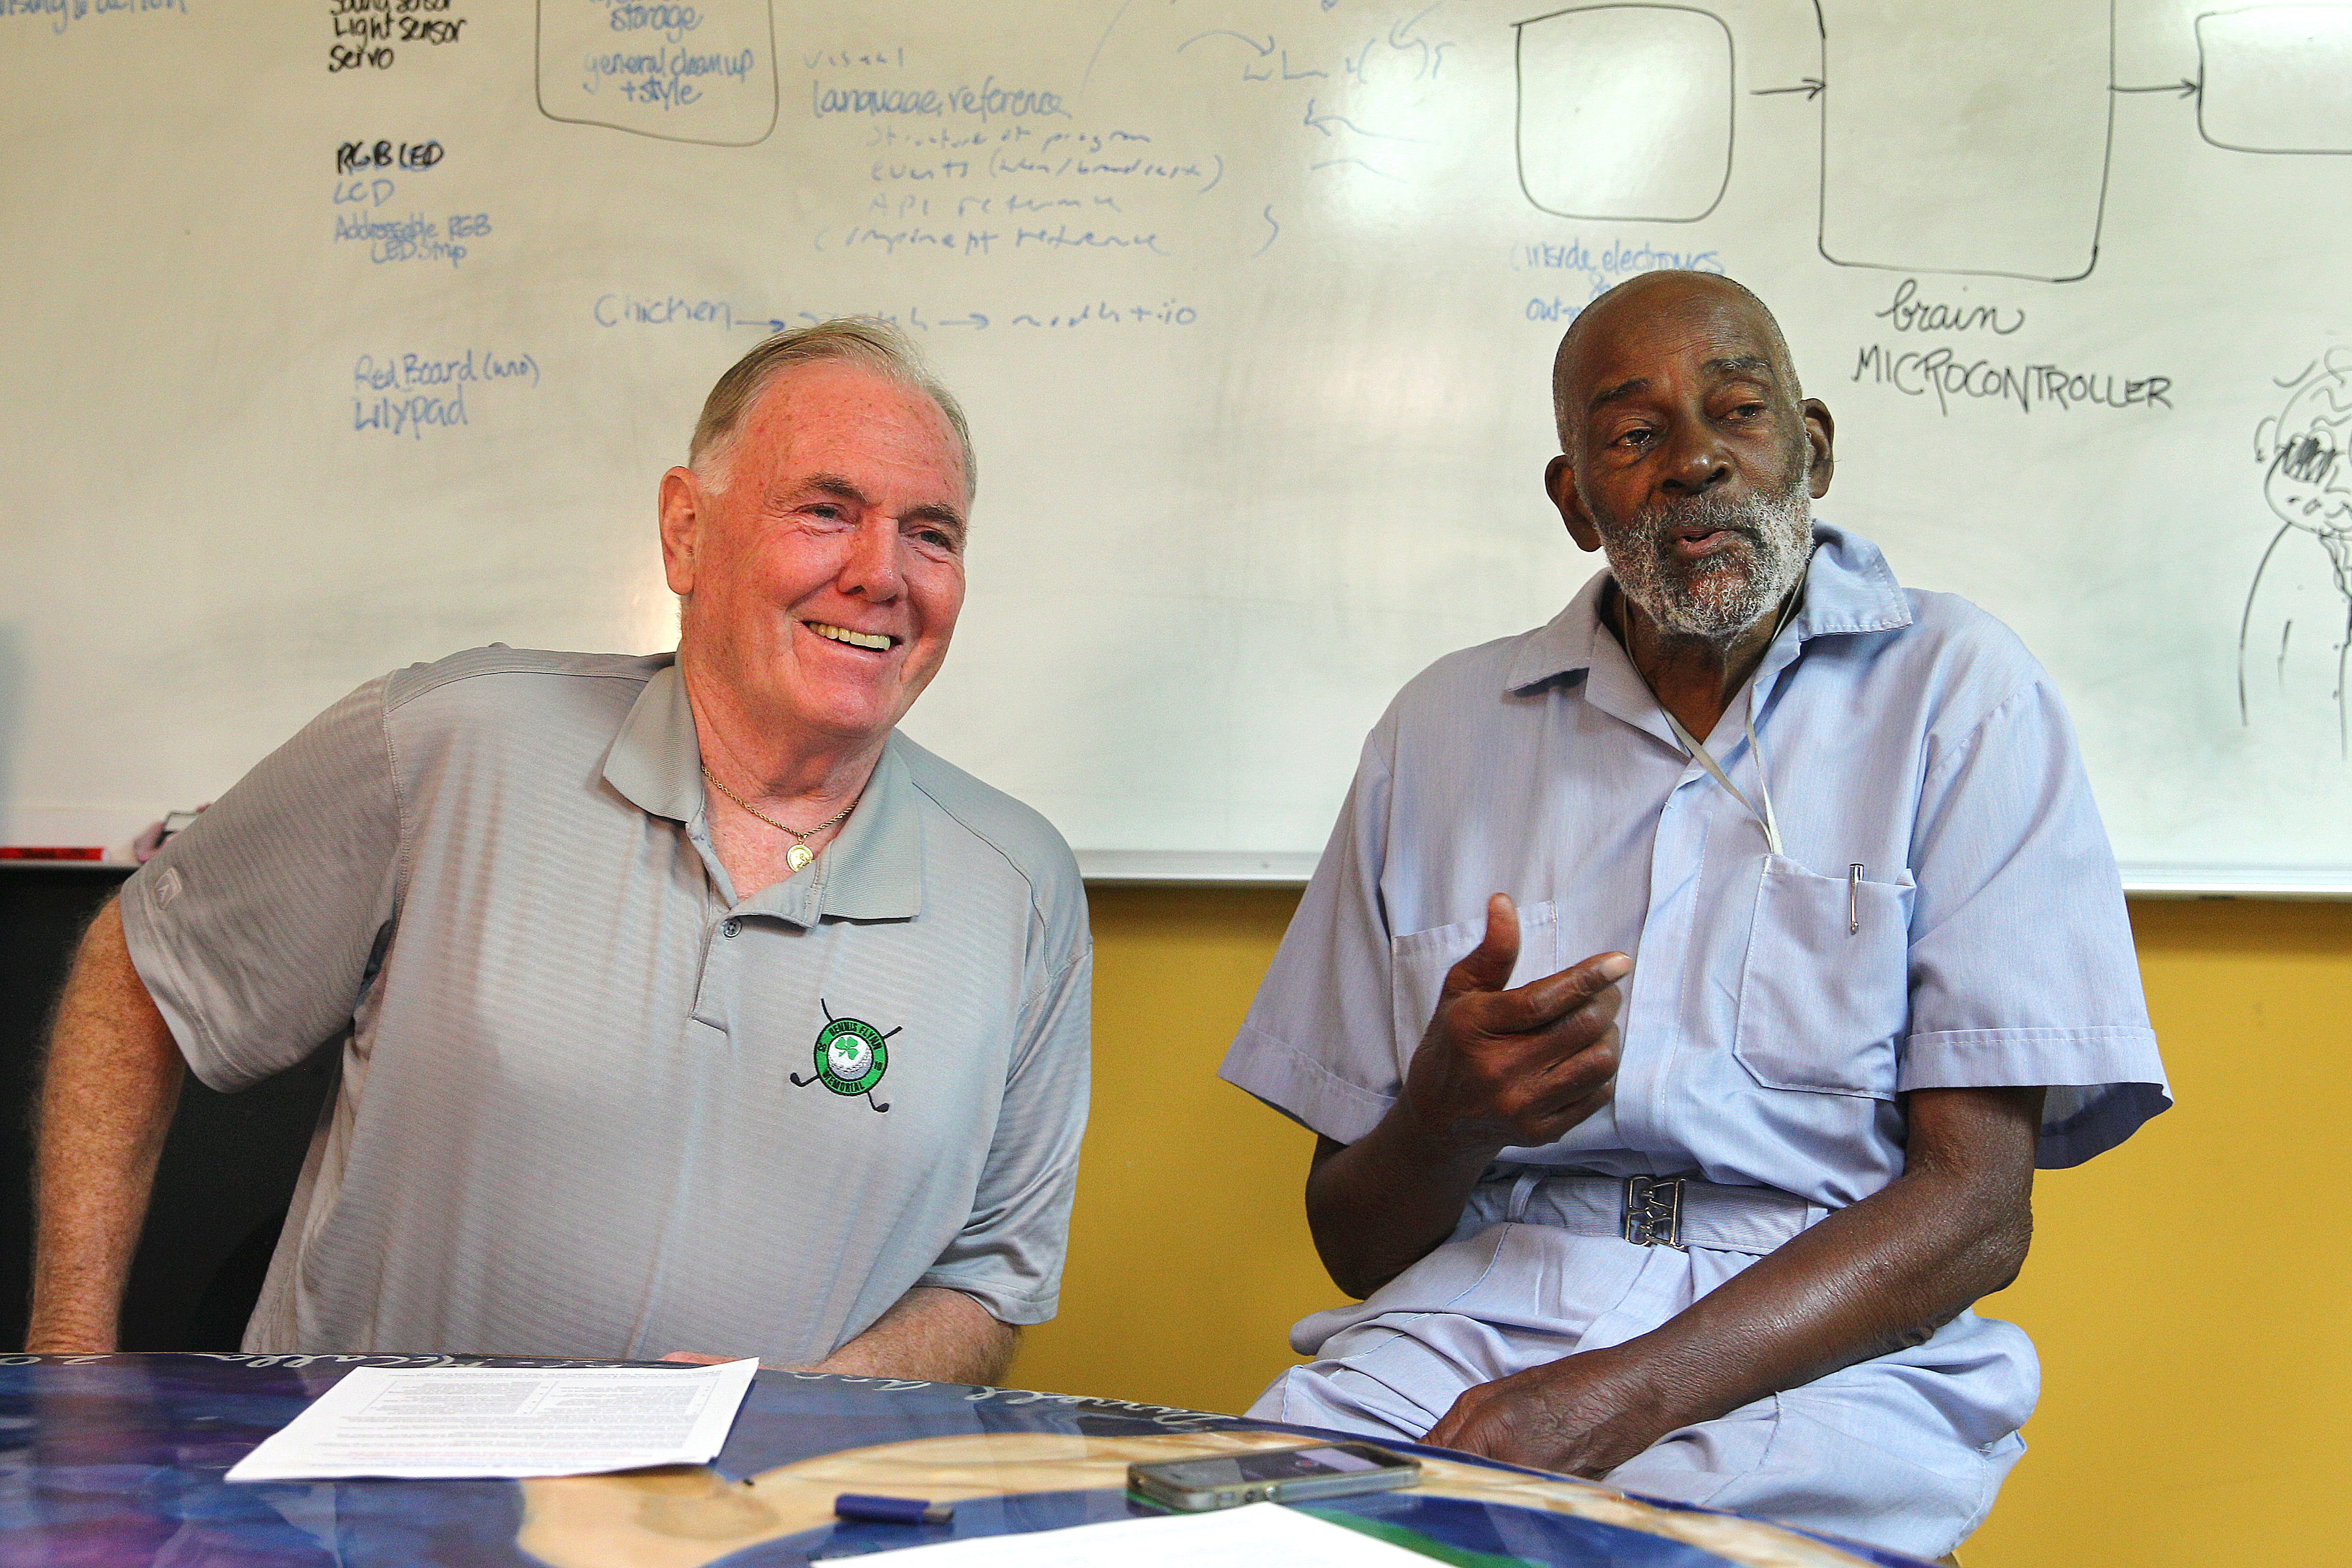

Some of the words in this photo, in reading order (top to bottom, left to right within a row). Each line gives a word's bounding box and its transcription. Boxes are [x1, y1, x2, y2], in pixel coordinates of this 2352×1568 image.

[337, 139, 392, 175] RGB
[398, 138, 445, 173] LED
[333, 177, 395, 207] LCD
[1874, 277, 2026, 335] brain
[1850, 343, 2173, 418] MICROCONTROLLER
[828, 1021, 858, 1037] DENNIS
[822, 1069, 866, 1093] MEMORIAL
